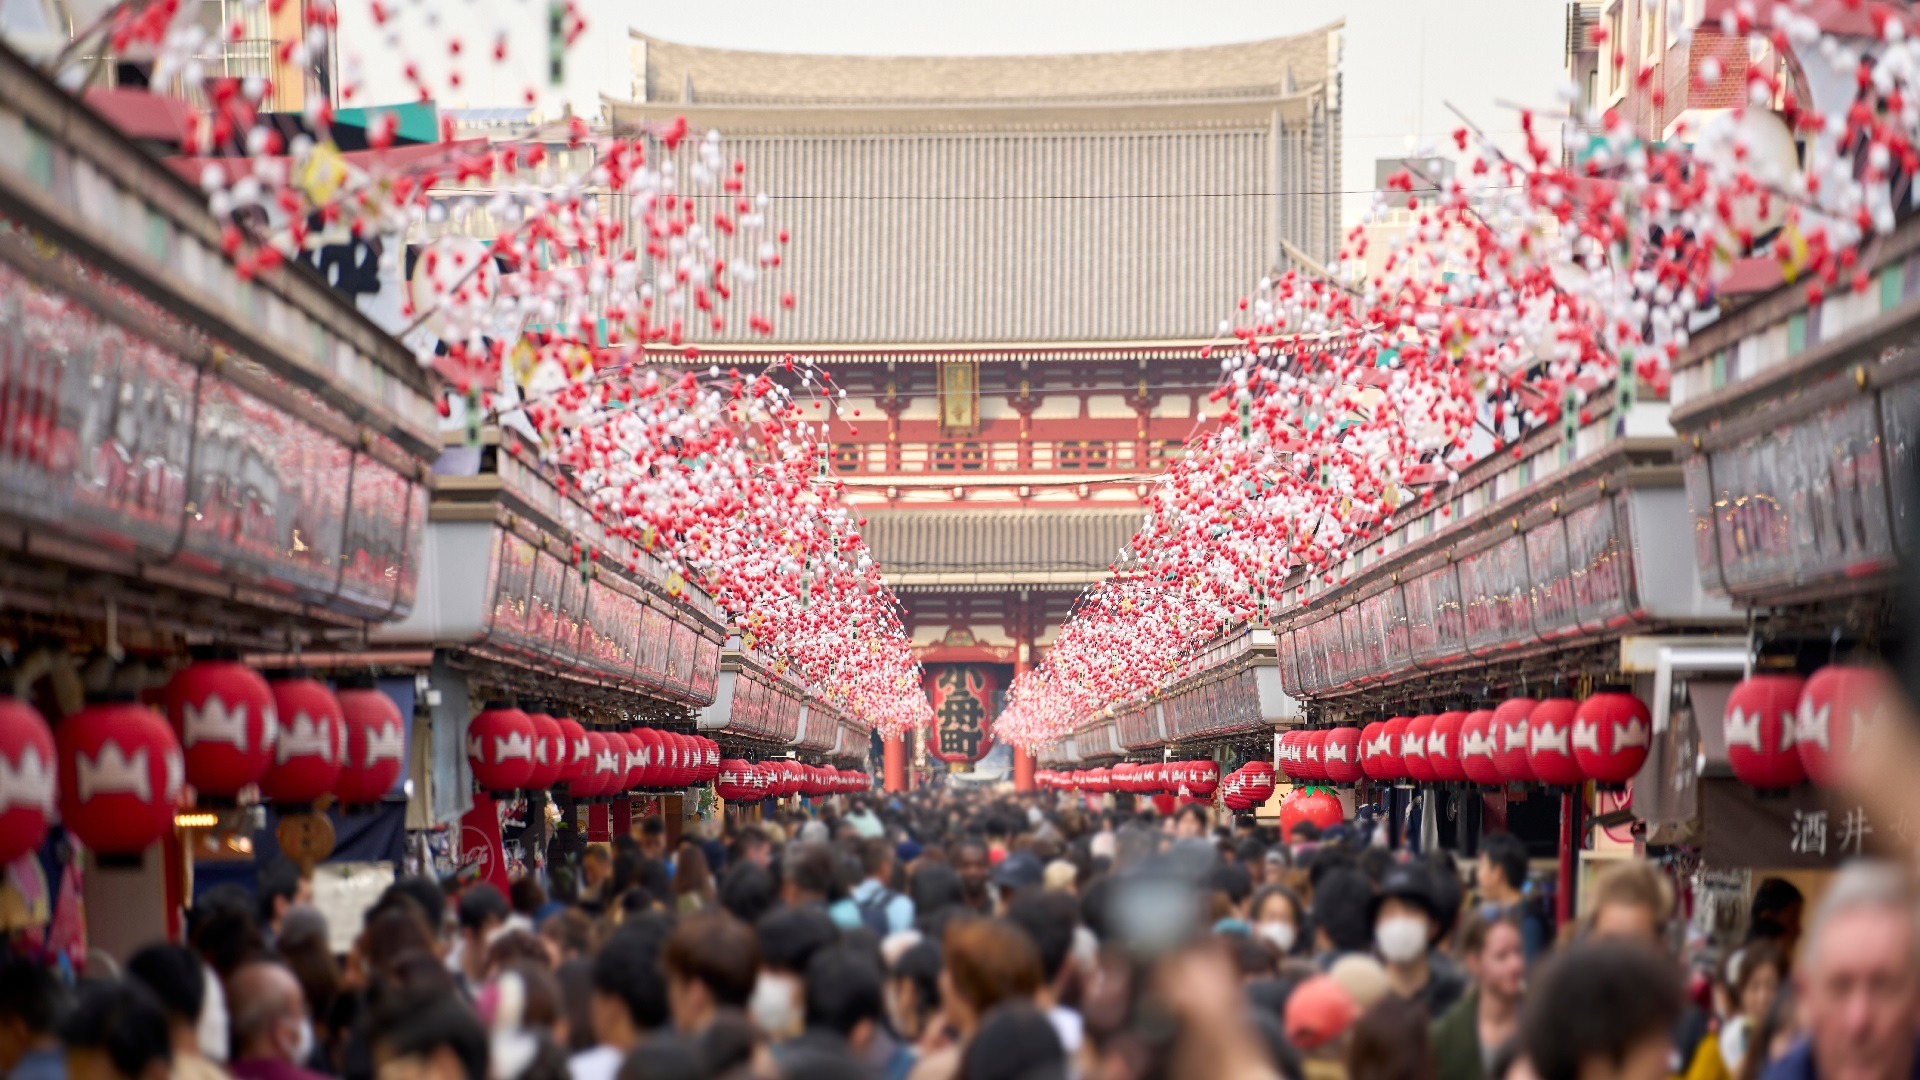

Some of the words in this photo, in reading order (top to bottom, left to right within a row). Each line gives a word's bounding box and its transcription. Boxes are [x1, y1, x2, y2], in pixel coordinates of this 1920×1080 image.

[938, 665, 984, 757] 小舟町
[1791, 806, 1909, 857] 酒井
